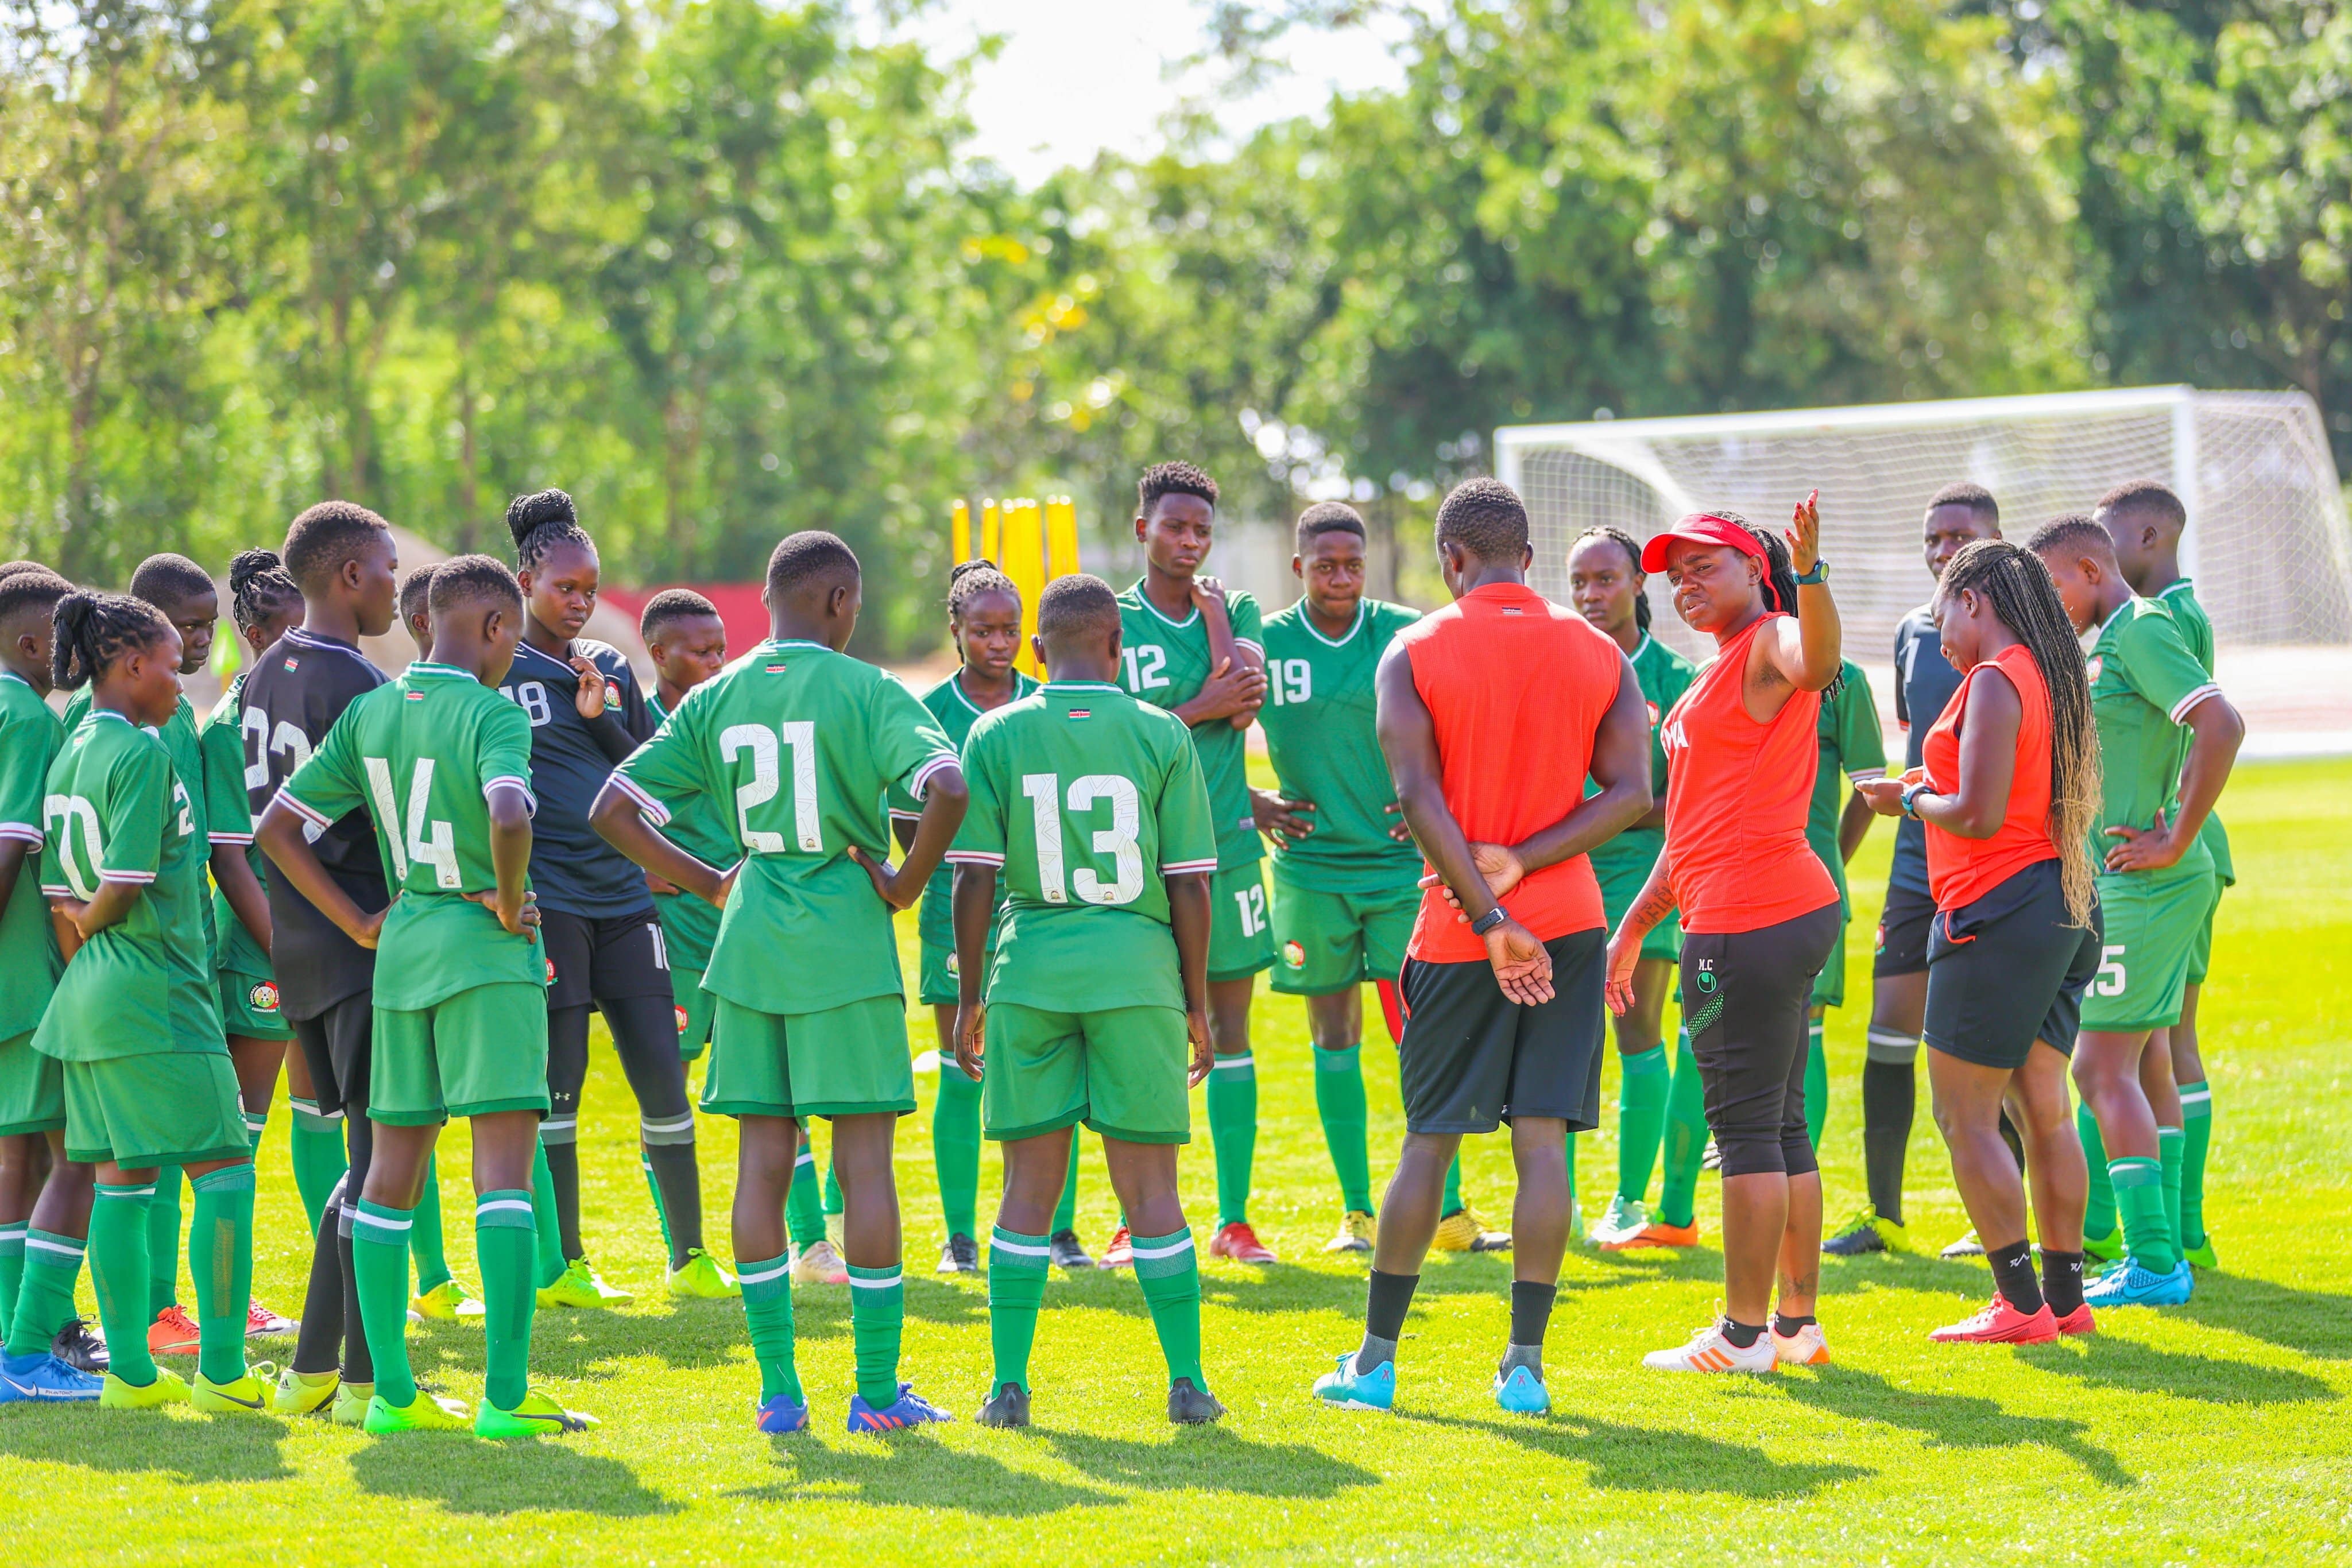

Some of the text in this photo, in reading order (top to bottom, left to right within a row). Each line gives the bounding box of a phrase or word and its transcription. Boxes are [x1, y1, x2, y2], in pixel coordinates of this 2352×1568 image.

[1122, 645, 1170, 693] 12
[1268, 659, 1312, 706] 19
[719, 721, 823, 852] 21
[363, 757, 462, 888] 14
[1023, 773, 1143, 905] 13
[1234, 883, 1266, 938] 12
[1699, 958, 1713, 971] M.C
[250, 985, 260, 1005] FOOTBALL
